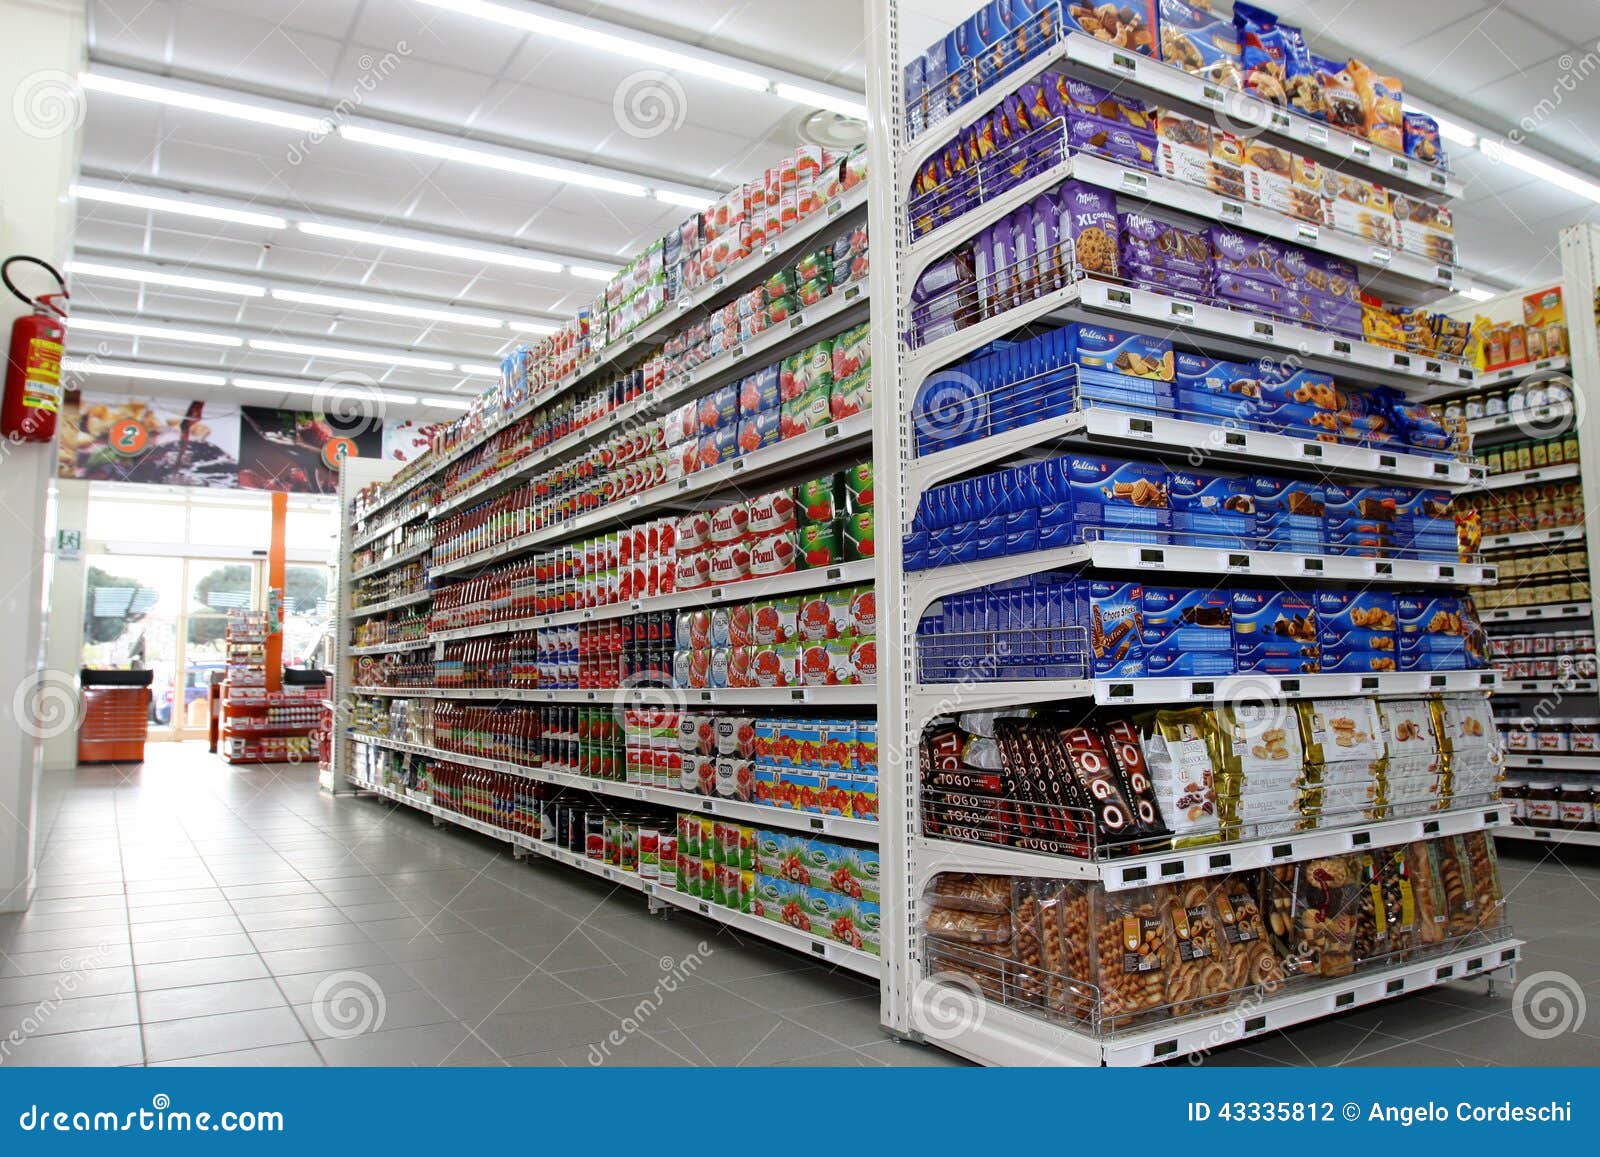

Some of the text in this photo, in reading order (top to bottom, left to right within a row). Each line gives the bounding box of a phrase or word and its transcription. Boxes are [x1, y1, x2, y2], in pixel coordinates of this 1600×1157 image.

[1076, 192, 1099, 206] Milka
[1076, 214, 1096, 227] XL
[1092, 211, 1115, 221] cookies
[1126, 213, 1153, 228] Milka
[1220, 234, 1244, 248] Milka
[1079, 327, 1107, 342] Bahlsen
[119, 426, 139, 446] 2
[1072, 459, 1099, 472] Bahlsen
[1174, 475, 1196, 486] Bahlsen
[1145, 592, 1169, 601] Bahlsen
[1233, 593, 1257, 603] Bahlsen
[1320, 593, 1342, 603] Bahlsen
[1103, 605, 1136, 622] Choco Sticks
[1012, 740, 1030, 792] TOGO
[1027, 740, 1046, 792] TOGO
[1041, 741, 1060, 794] TOGO
[1114, 721, 1154, 824] TOGO
[939, 774, 970, 787] TOGO
[1072, 730, 1124, 829] TOGO
[946, 795, 978, 807] TOGO
[948, 810, 979, 823] TOGO
[948, 827, 979, 840] TOGO
[1023, 838, 1058, 852] TOGO
